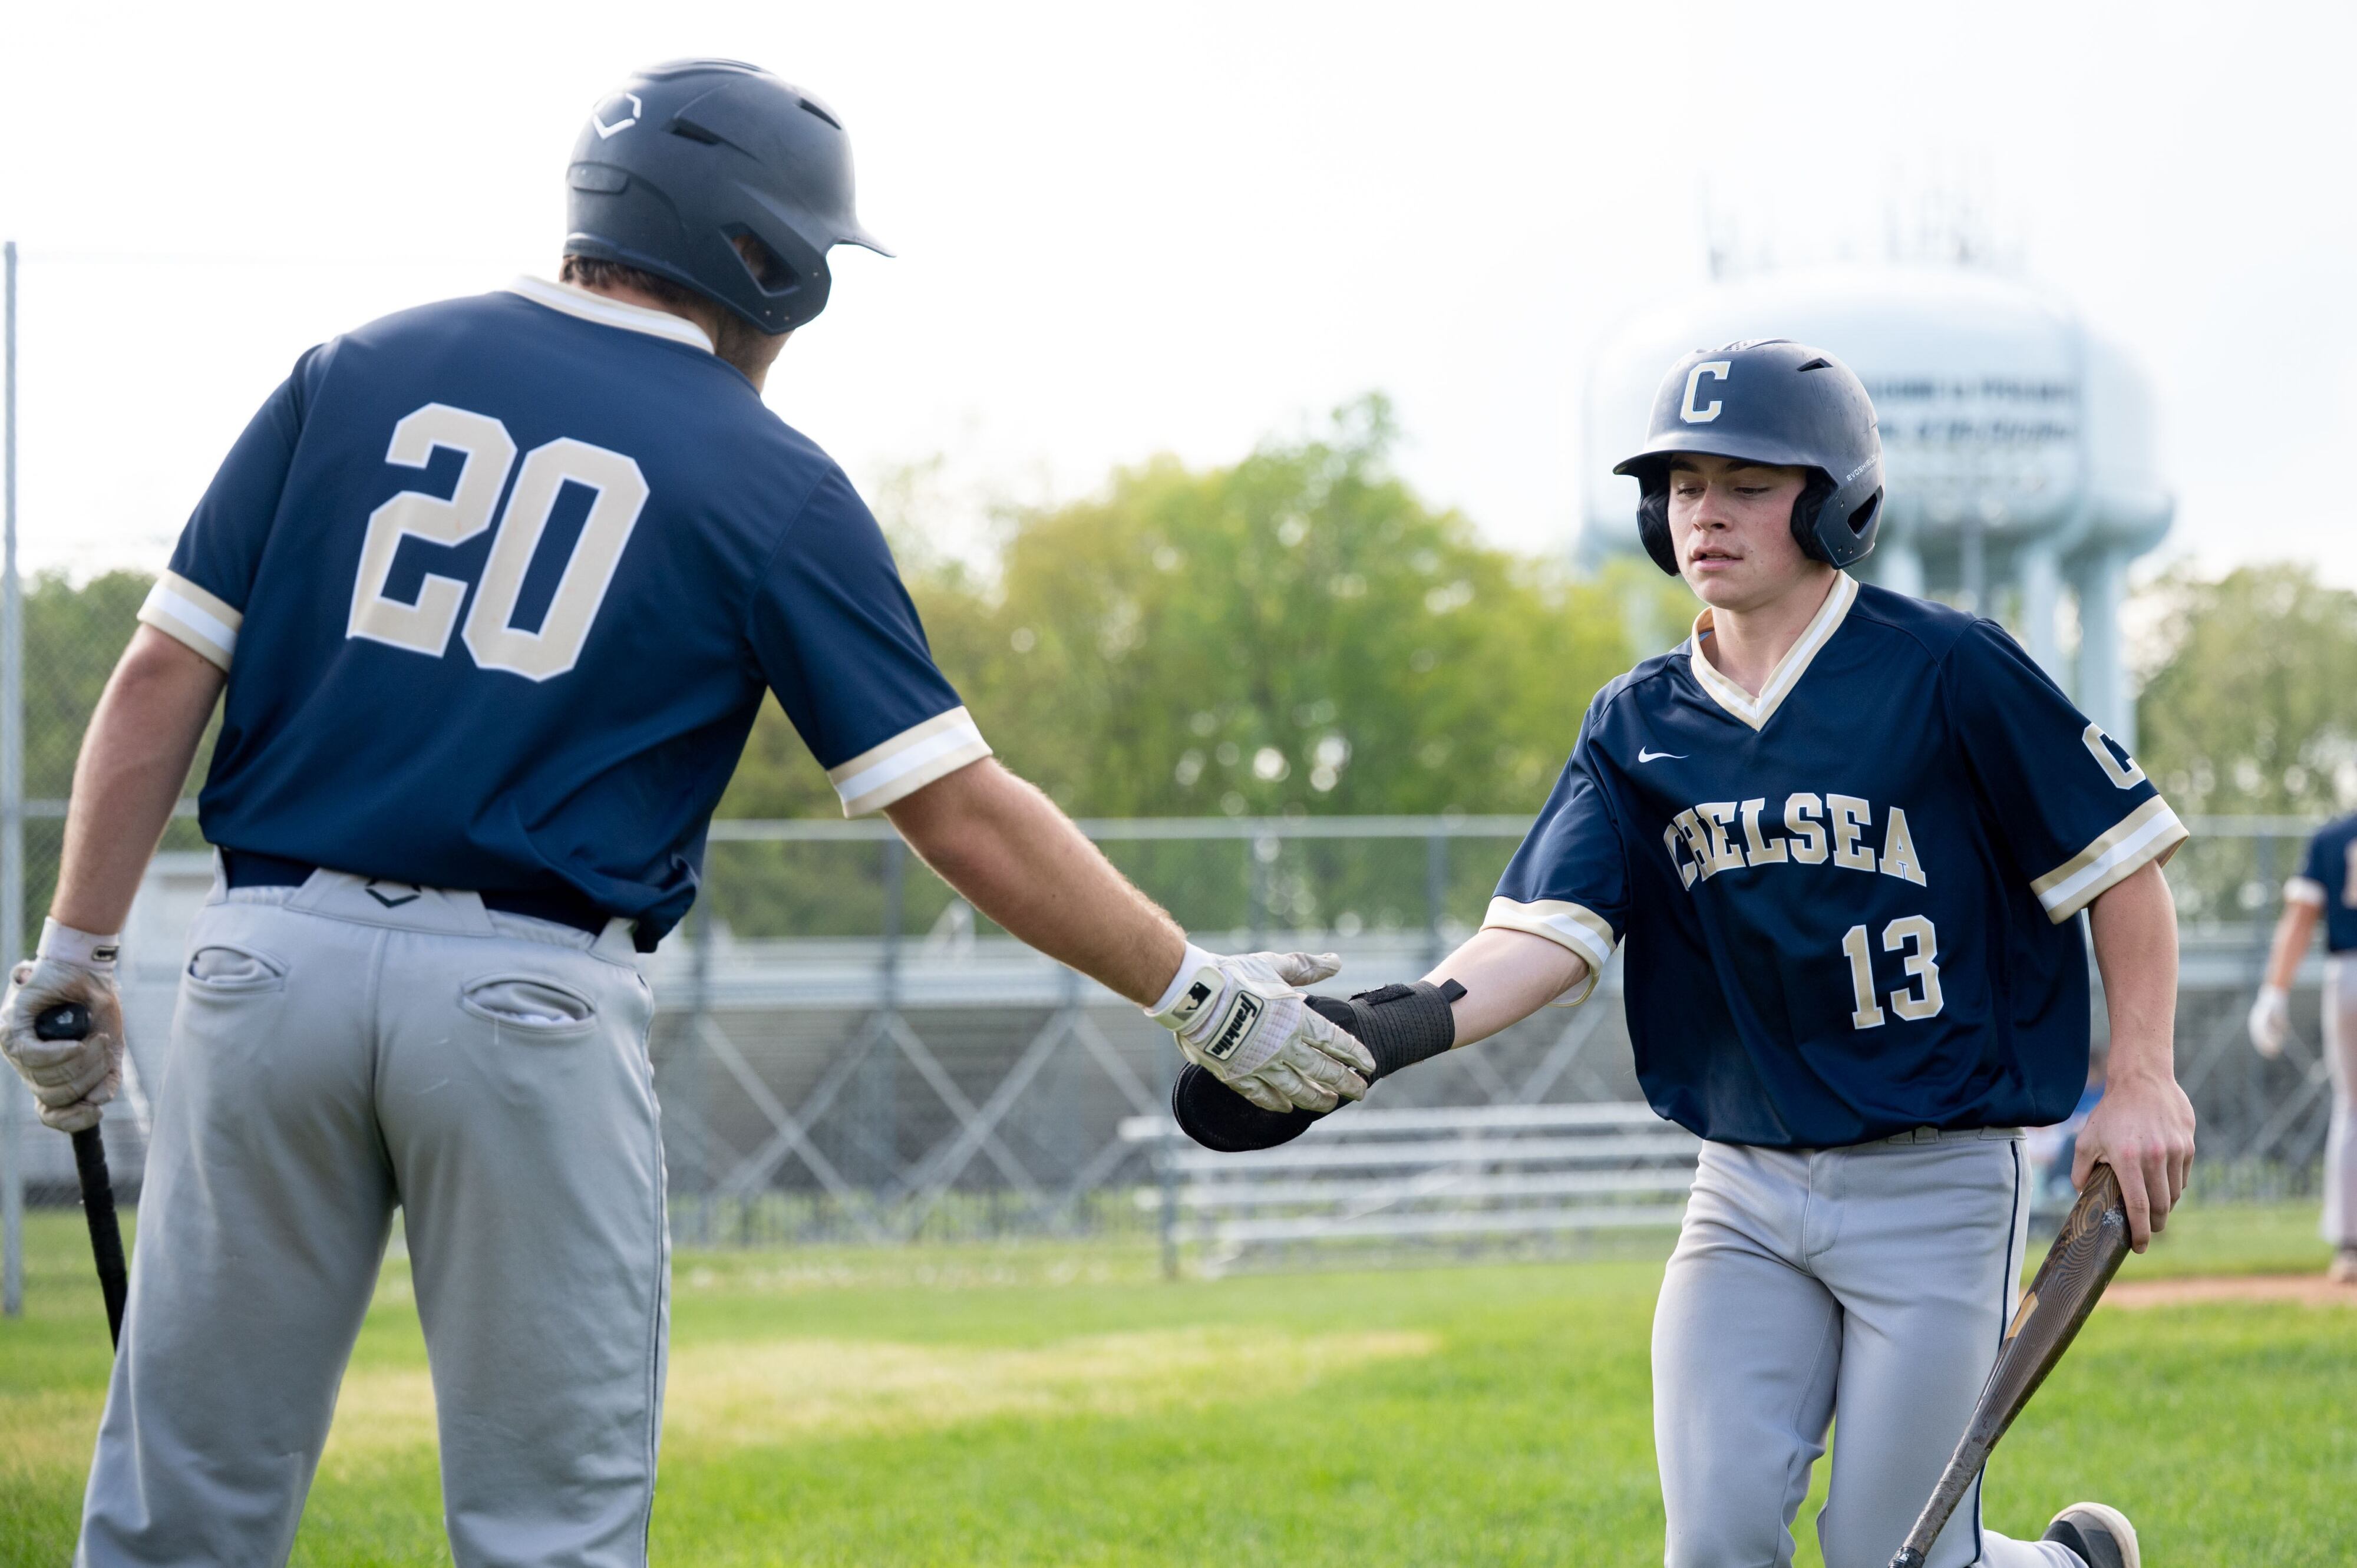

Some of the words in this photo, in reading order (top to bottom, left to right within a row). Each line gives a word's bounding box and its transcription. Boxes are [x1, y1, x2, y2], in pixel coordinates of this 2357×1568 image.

[1680, 361, 1731, 423] C
[346, 402, 650, 683] 20
[2082, 722, 2146, 790] C
[1663, 793, 1926, 891] CHELSEA
[1842, 915, 1943, 1029] 13
